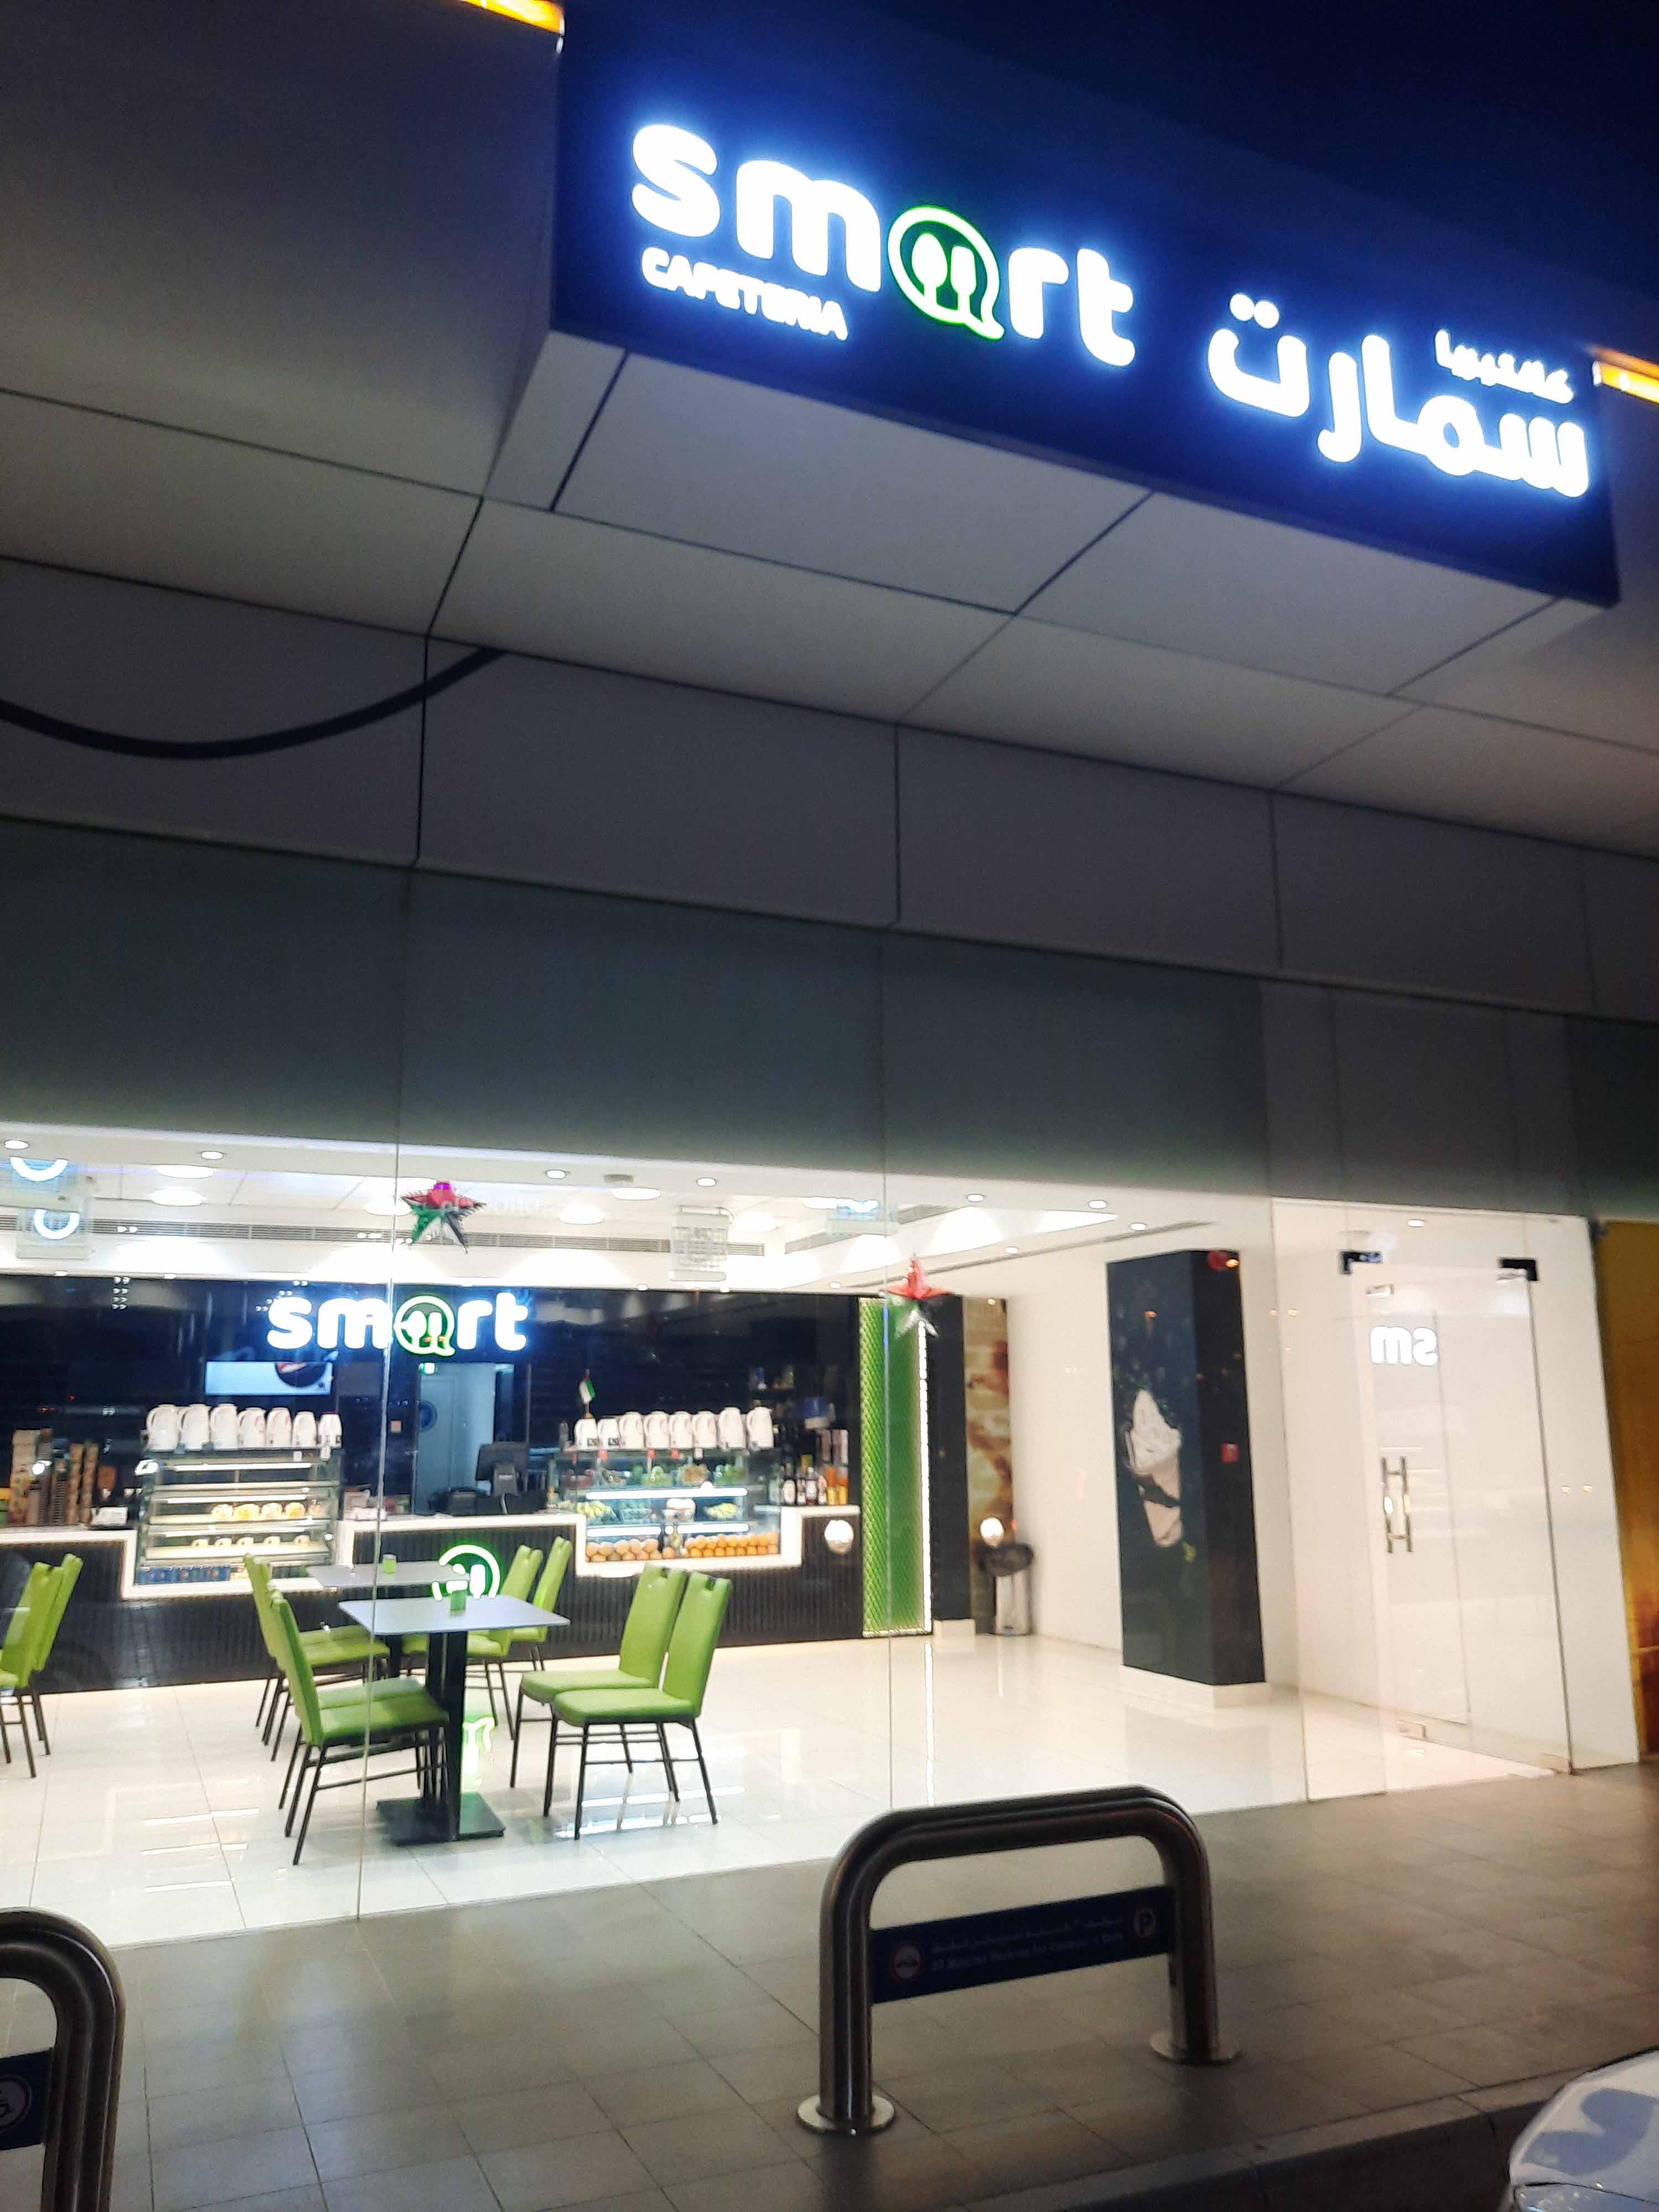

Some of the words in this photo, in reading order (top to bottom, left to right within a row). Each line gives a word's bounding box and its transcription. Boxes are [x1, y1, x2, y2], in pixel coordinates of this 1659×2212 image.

[632, 124, 1135, 366] smart
[1208, 294, 1590, 497] سمارت
[267, 1292, 528, 1356] smart
